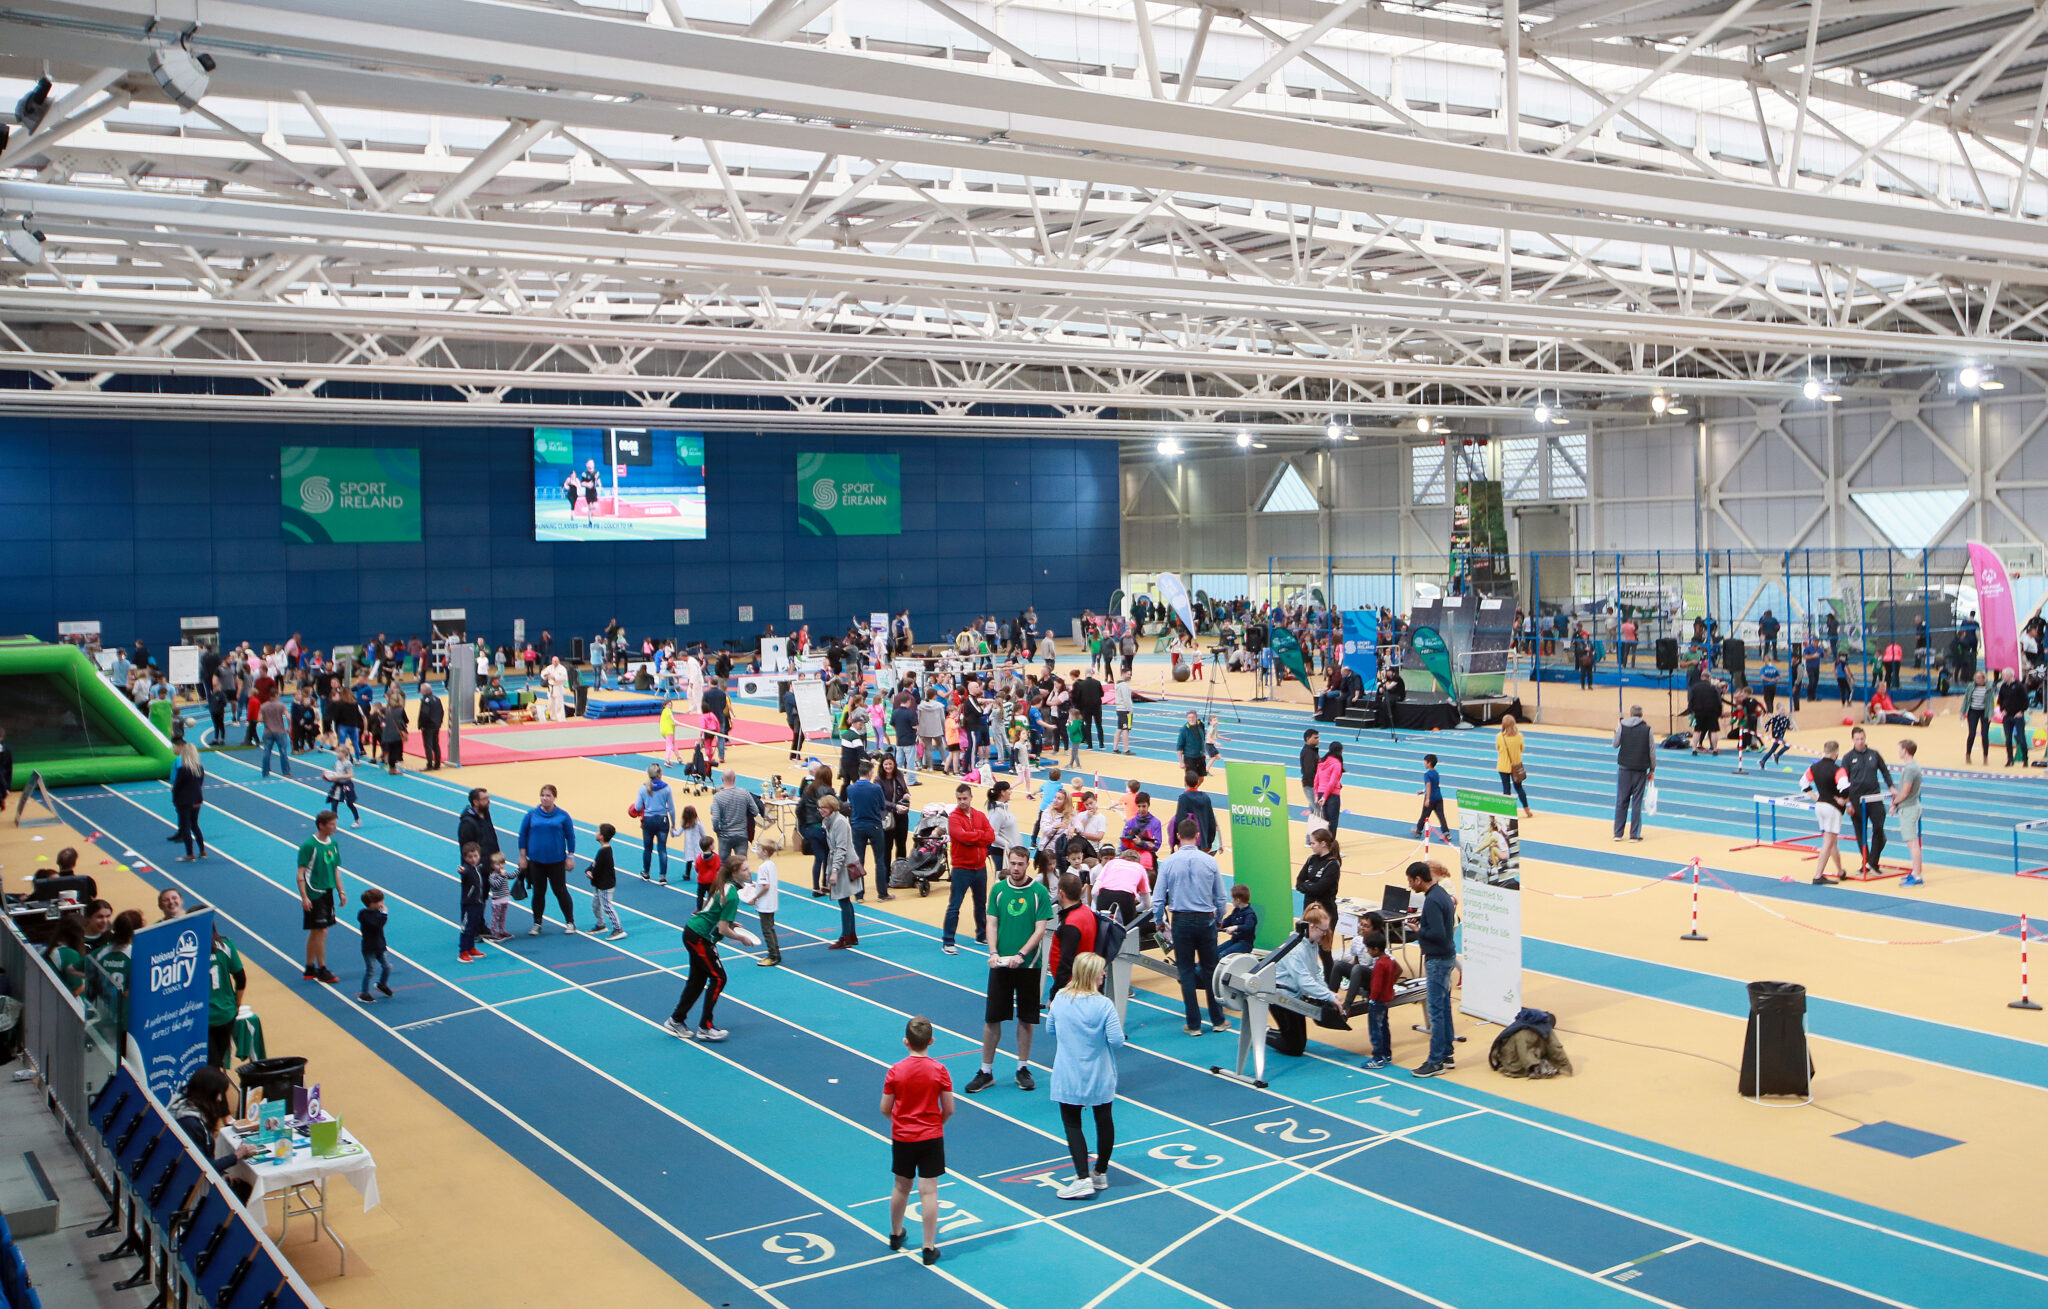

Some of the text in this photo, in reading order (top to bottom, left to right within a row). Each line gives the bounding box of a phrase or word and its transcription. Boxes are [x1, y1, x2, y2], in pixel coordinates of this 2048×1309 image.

[339, 482, 386, 495] SPORT
[841, 482, 874, 493] SPÓRT
[340, 496, 404, 508] IRELAND
[842, 494, 887, 506] ÉIREANN
[1231, 803, 1272, 817] ROWING
[1232, 814, 1272, 827] IRELAND
[1464, 885, 1496, 899] Committed
[1463, 899, 1509, 914] giving students
[1468, 911, 1483, 919] sport
[1464, 921, 1510, 937] pathway for life
[151, 948, 176, 965] National
[151, 957, 198, 992] Dairy
[162, 984, 181, 995] COUNCIL
[152, 1014, 195, 1040] across the day
[1355, 1095, 1424, 1117] 1
[1253, 1117, 1332, 1144] 2
[1147, 1143, 1225, 1170] 3
[904, 1199, 984, 1234] 5
[761, 1231, 836, 1265] 6
